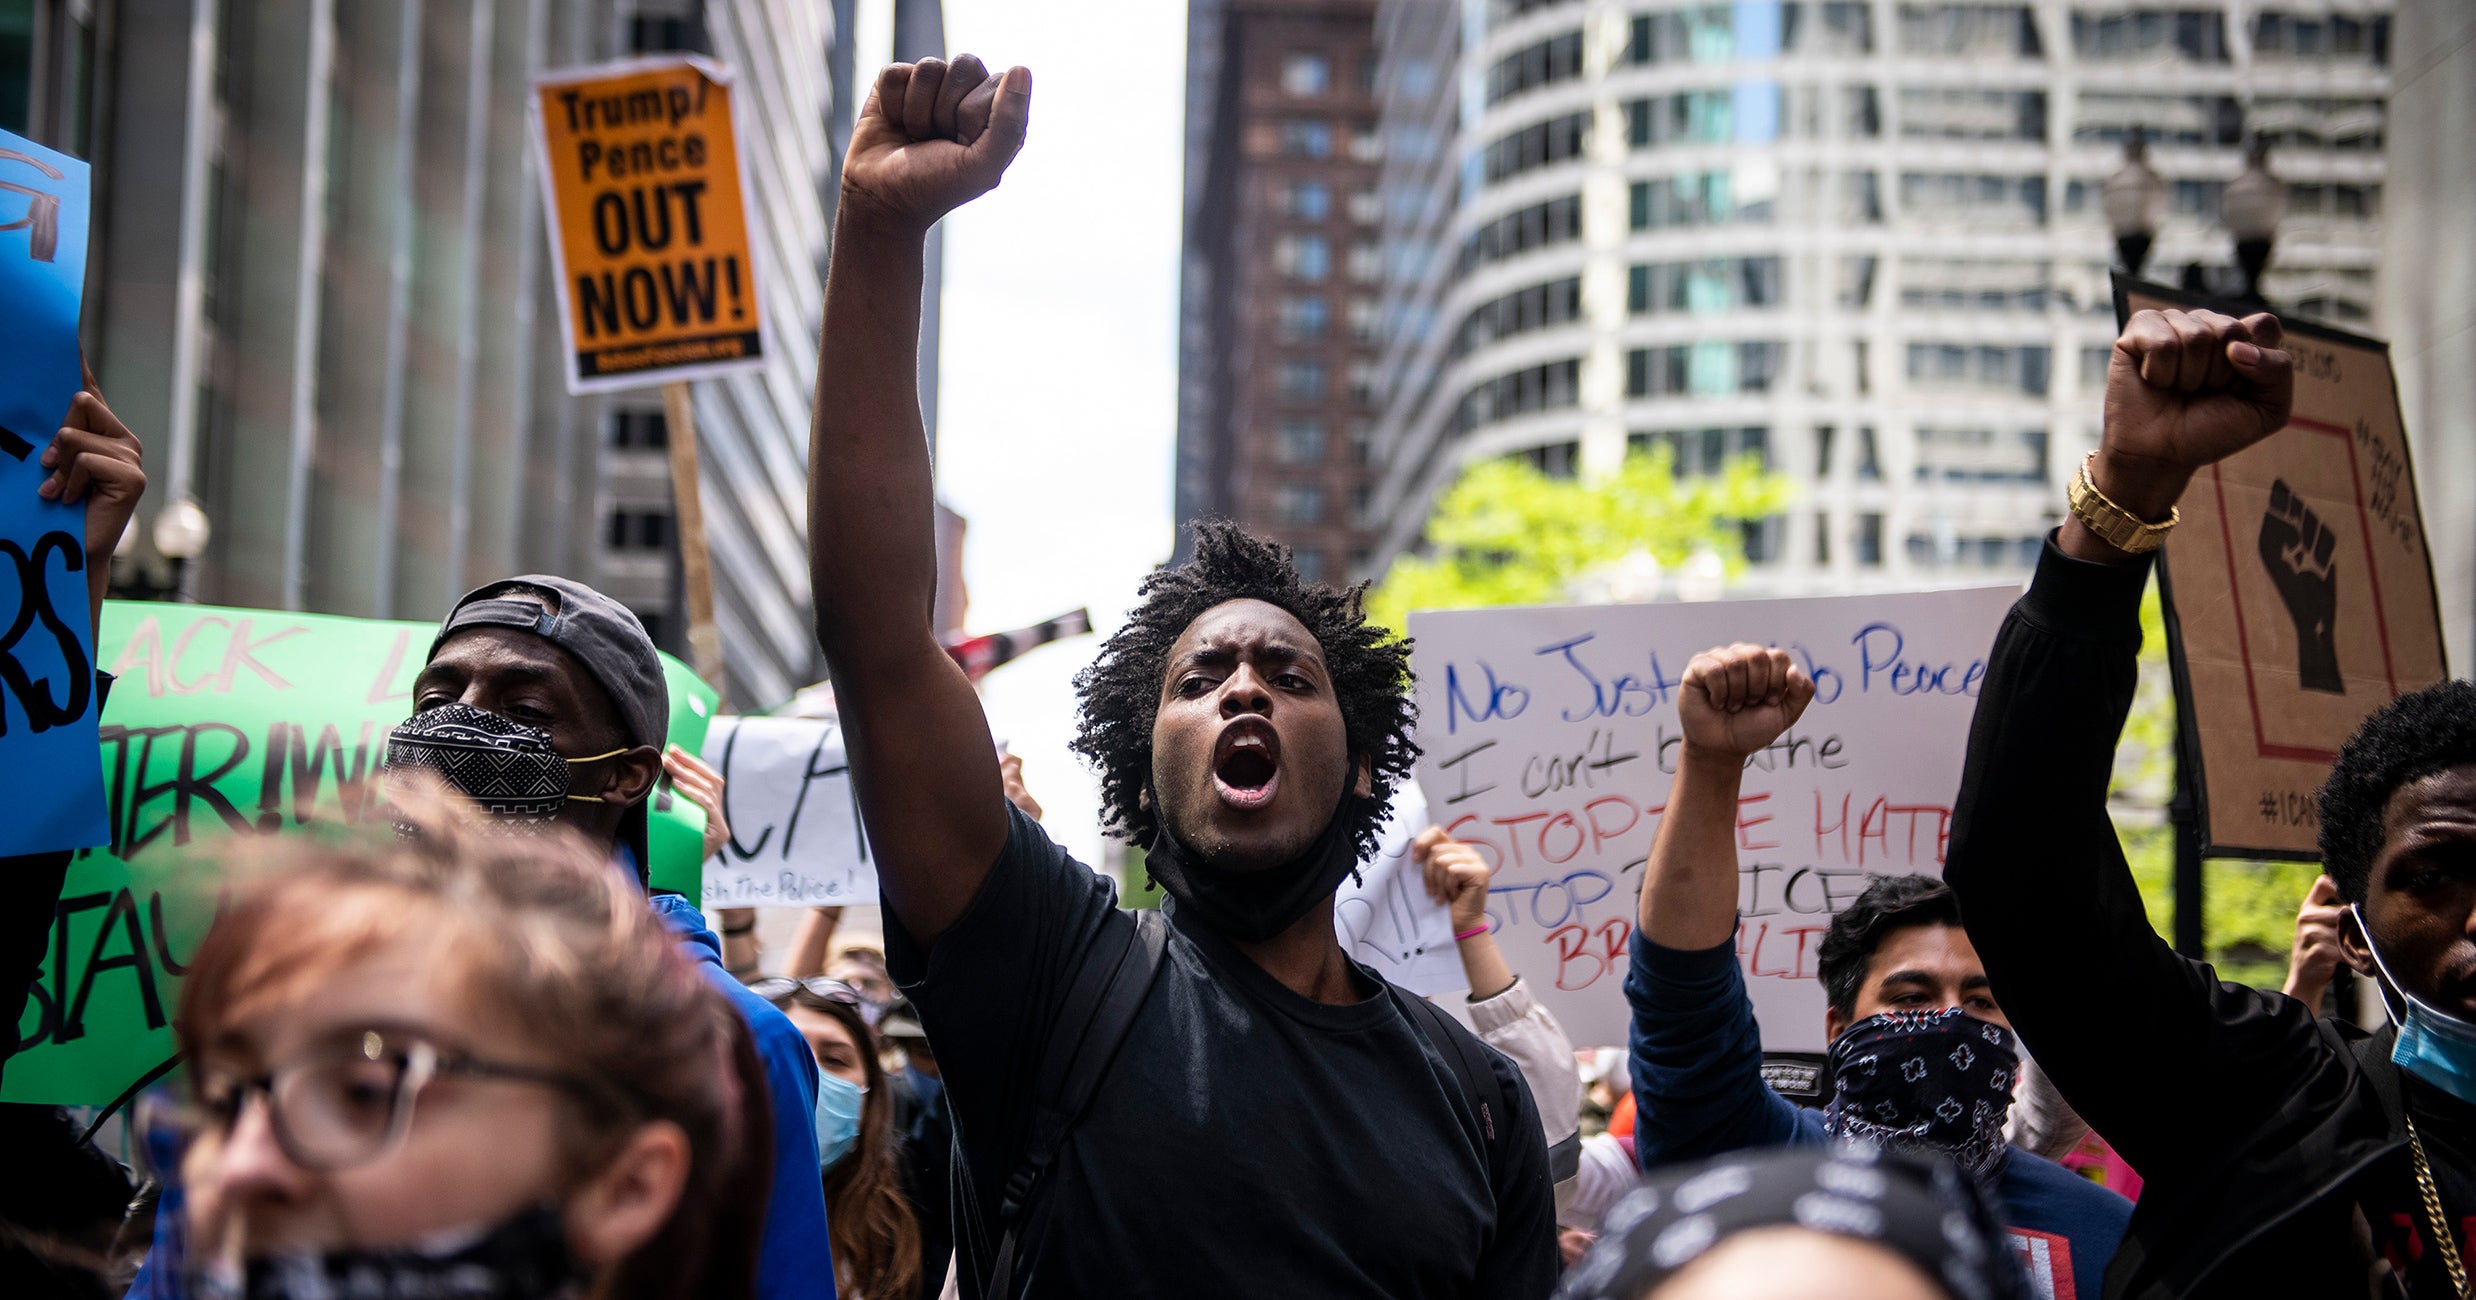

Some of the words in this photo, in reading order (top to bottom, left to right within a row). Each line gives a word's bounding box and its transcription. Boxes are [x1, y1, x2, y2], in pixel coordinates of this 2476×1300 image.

[560, 77, 708, 132] Trump/
[578, 134, 706, 183] Pence
[593, 179, 706, 258] OUT
[576, 254, 745, 338] NOW!
[0, 530, 91, 738] RS
[108, 614, 312, 698] ACK
[1445, 659, 1530, 735] No
[1533, 631, 1684, 723] Just
[1768, 640, 1843, 705] o
[1851, 620, 1986, 697] Peace
[100, 723, 284, 862] TER!
[716, 717, 868, 866] CA
[1438, 738, 1498, 805] I
[1520, 727, 1640, 799] can't
[1446, 795, 1642, 878] STOP
[778, 867, 854, 901] Police!
